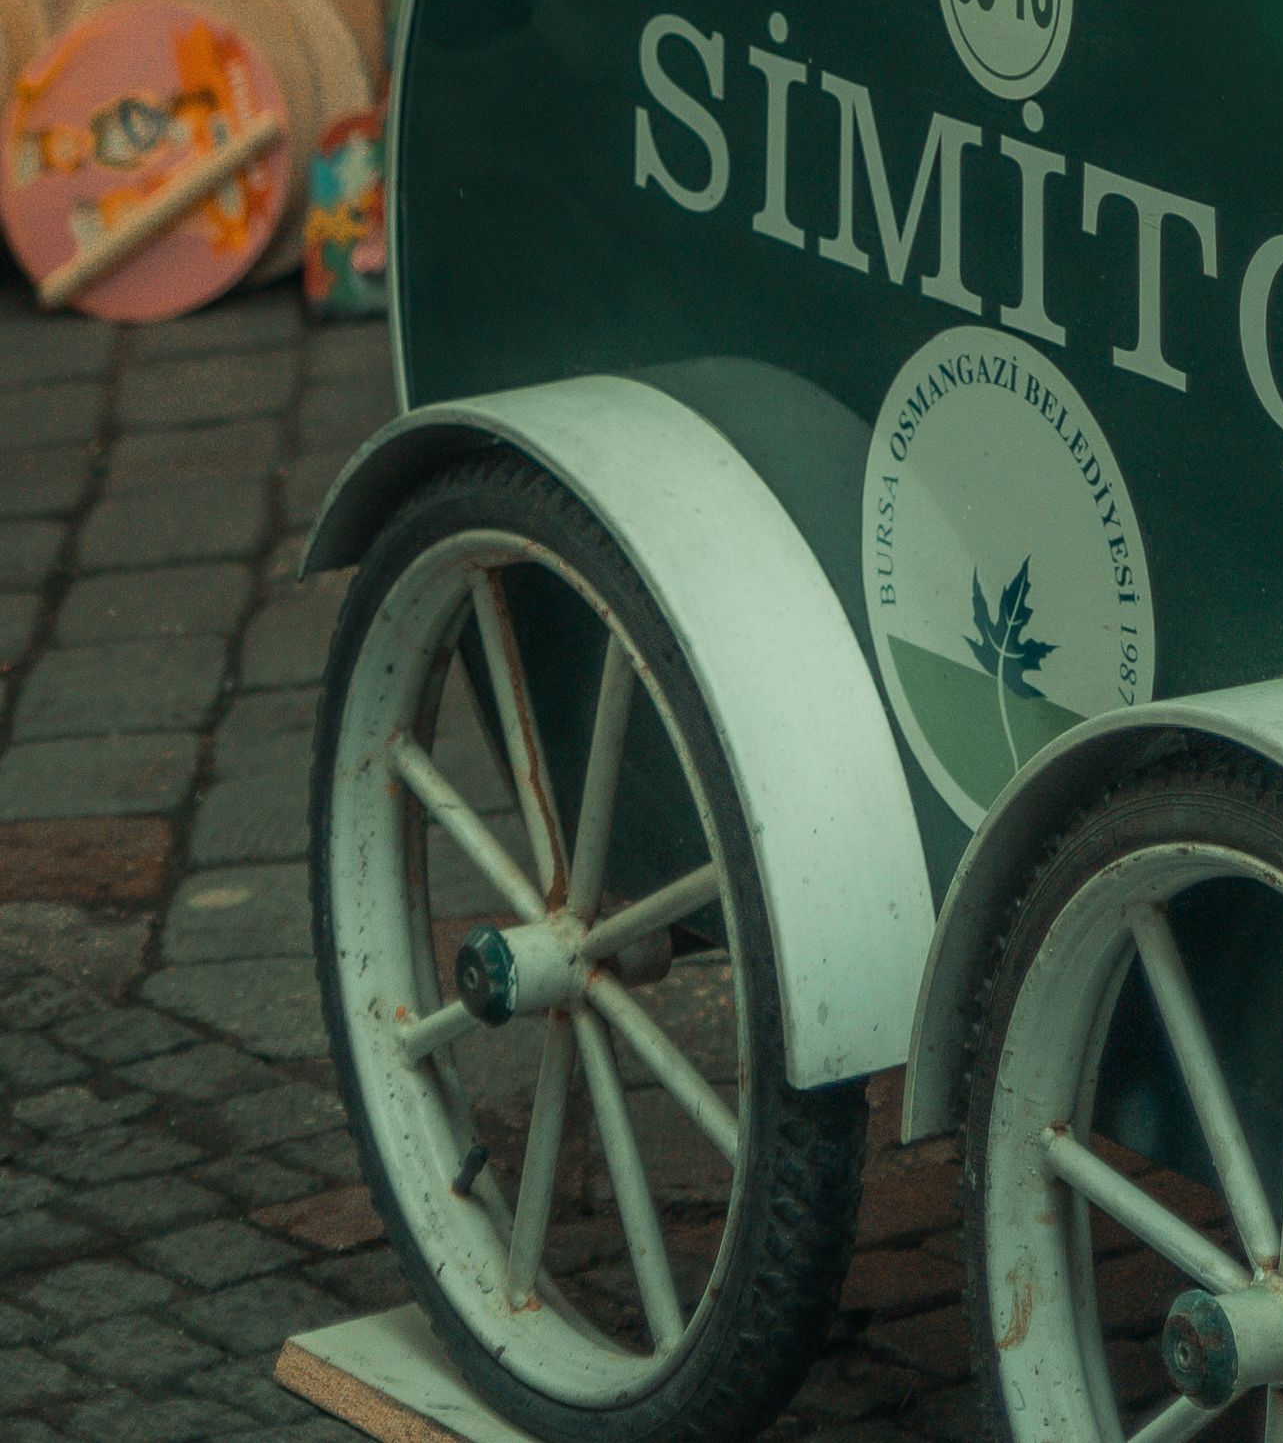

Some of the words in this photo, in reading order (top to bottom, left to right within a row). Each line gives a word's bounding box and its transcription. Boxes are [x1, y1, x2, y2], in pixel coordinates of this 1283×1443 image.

[876, 474, 899, 606] BURSA
[890, 354, 1018, 463] OSMANGAZİ
[1023, 371, 1141, 605] BELEDİYESİ
[1119, 624, 1138, 707] 1987
